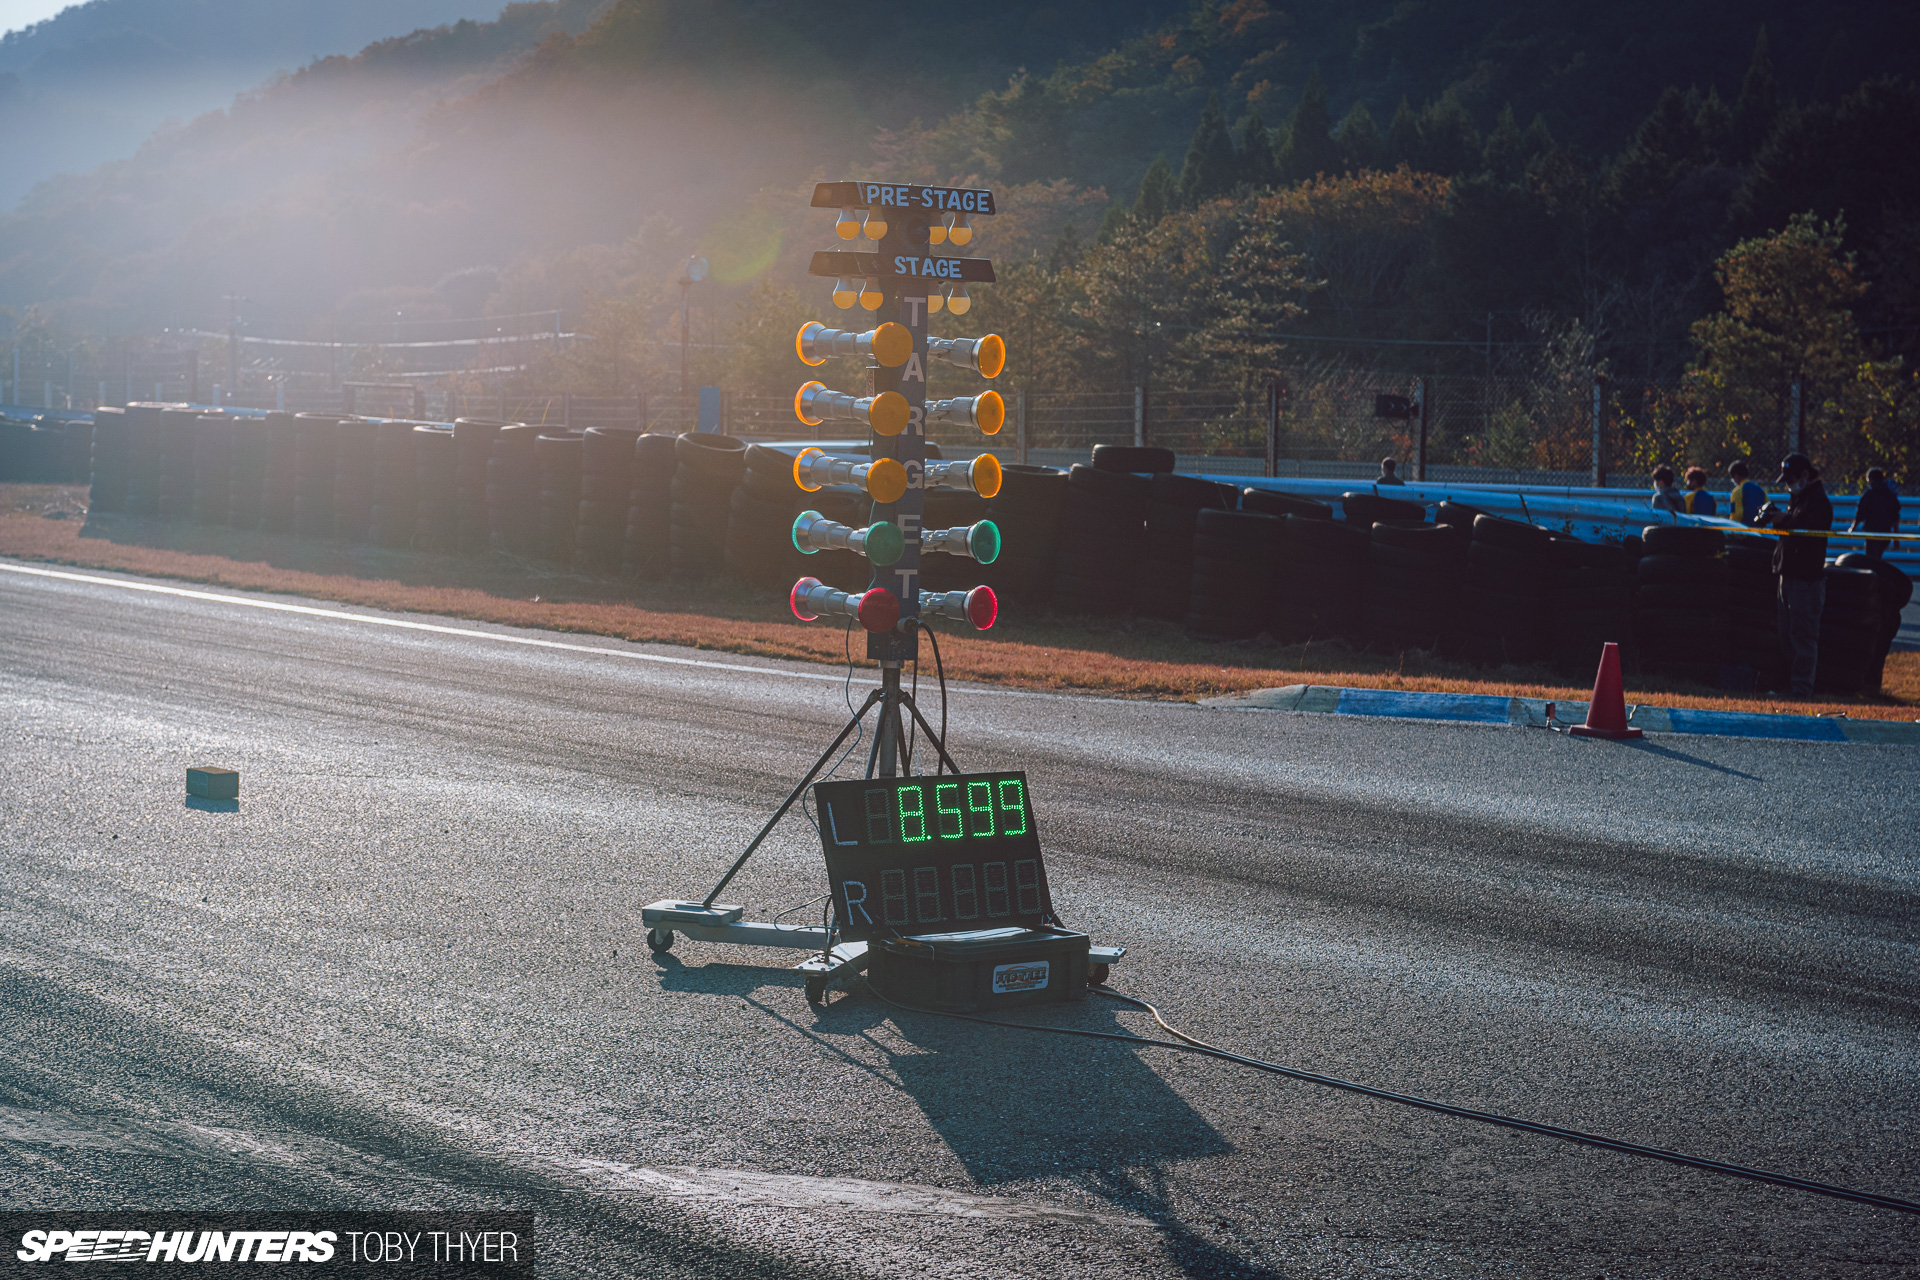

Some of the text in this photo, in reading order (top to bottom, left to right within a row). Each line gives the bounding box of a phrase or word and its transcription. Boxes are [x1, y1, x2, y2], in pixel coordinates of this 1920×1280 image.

[866, 184, 990, 212] PRE-STAGE
[894, 256, 962, 279] STAGE
[894, 296, 927, 600] TARGET
[827, 778, 1027, 845] L 8.599
[842, 880, 874, 926] R
